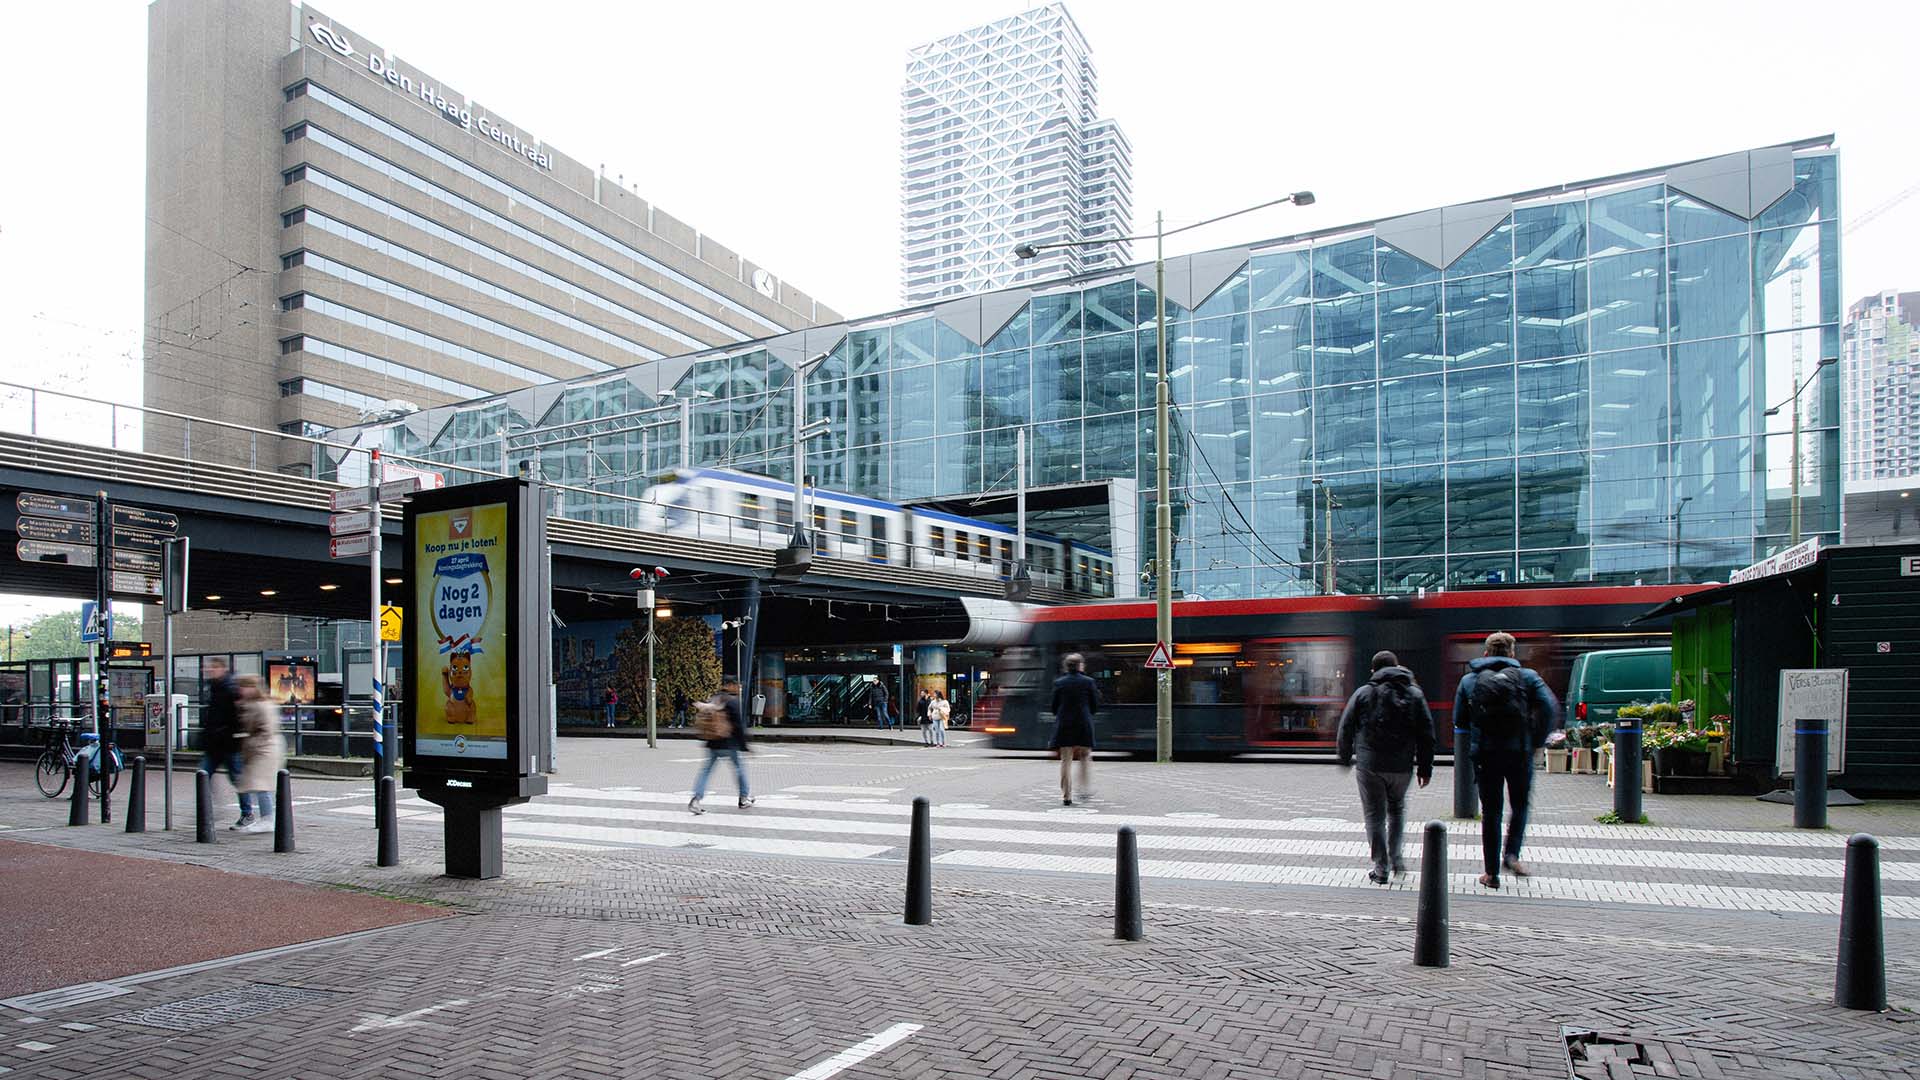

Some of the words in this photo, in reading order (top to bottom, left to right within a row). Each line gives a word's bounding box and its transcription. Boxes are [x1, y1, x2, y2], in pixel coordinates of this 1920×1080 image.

[368, 52, 412, 93] Den
[419, 82, 472, 129] Haag
[477, 116, 553, 171] Centraal
[425, 543, 446, 554] Koop
[447, 542, 459, 551] nu
[461, 539, 470, 552] je
[471, 537, 497, 548] loten!
[457, 556, 469, 565] april
[441, 586, 469, 604] Nog
[471, 583, 479, 599] 2
[1831, 594, 1840, 606] 4
[439, 604, 482, 622] dagen
